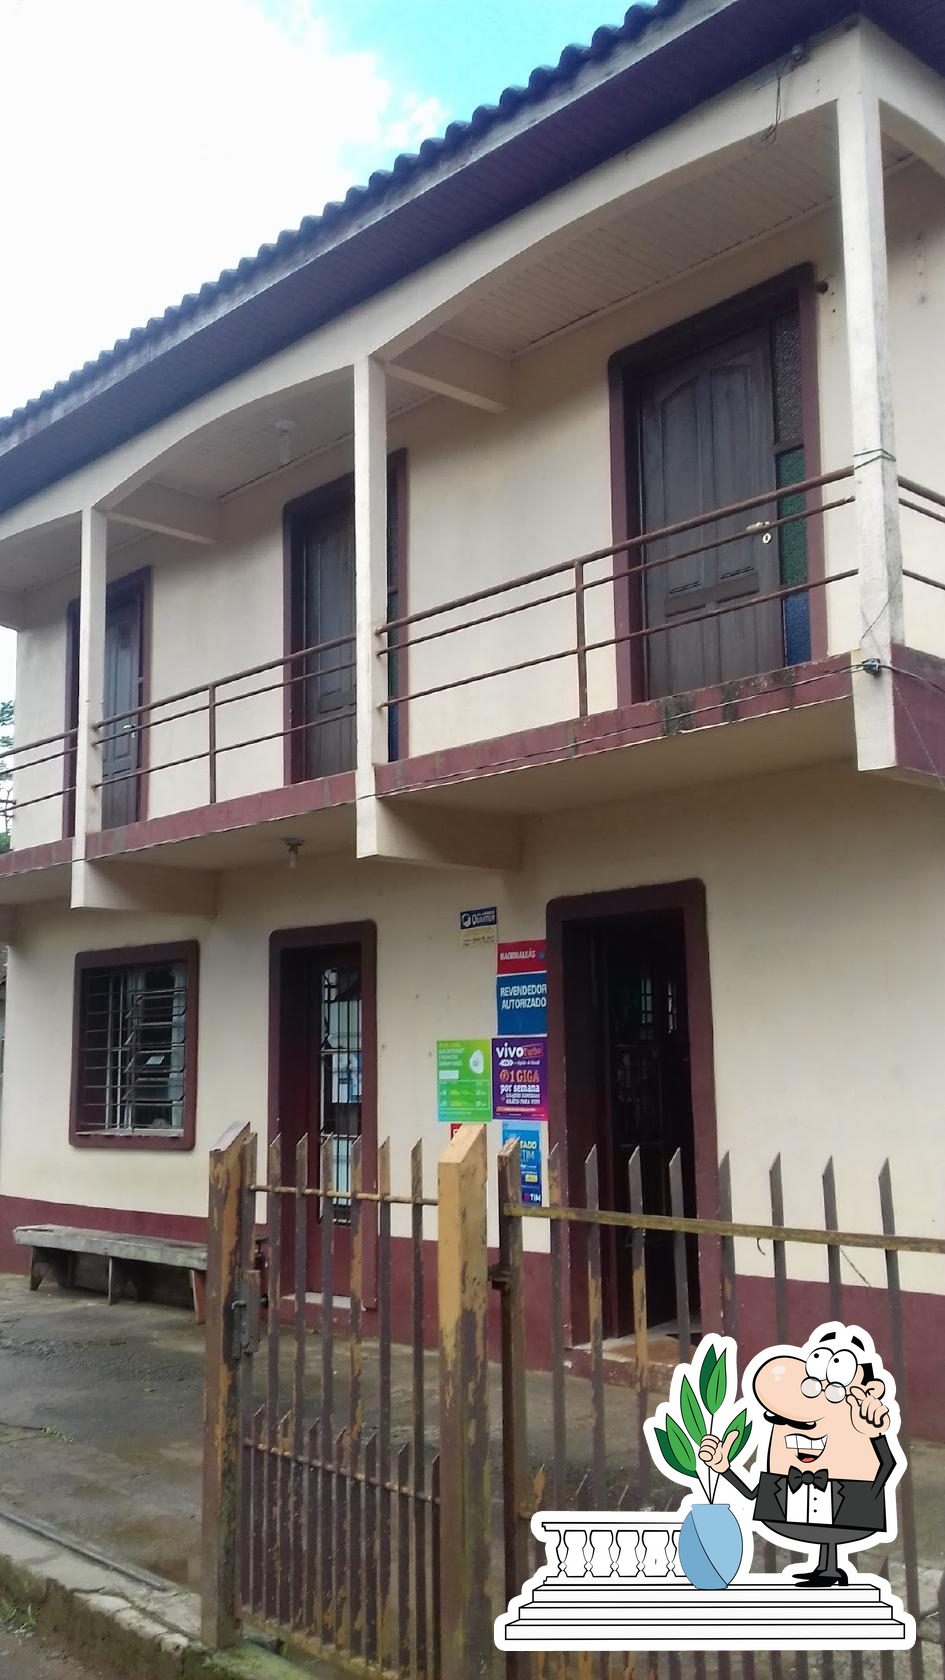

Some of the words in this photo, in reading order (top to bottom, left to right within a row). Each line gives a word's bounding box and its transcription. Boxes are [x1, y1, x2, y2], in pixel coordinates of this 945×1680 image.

[500, 984, 547, 997] REVENDEDOR
[501, 997, 547, 1010] AUTORIZADO
[496, 1042, 524, 1058] vivo
[516, 1069, 540, 1083] GIGA
[500, 1084, 512, 1094] por
[513, 1084, 540, 1093] semana
[530, 1193, 541, 1202] TIM
